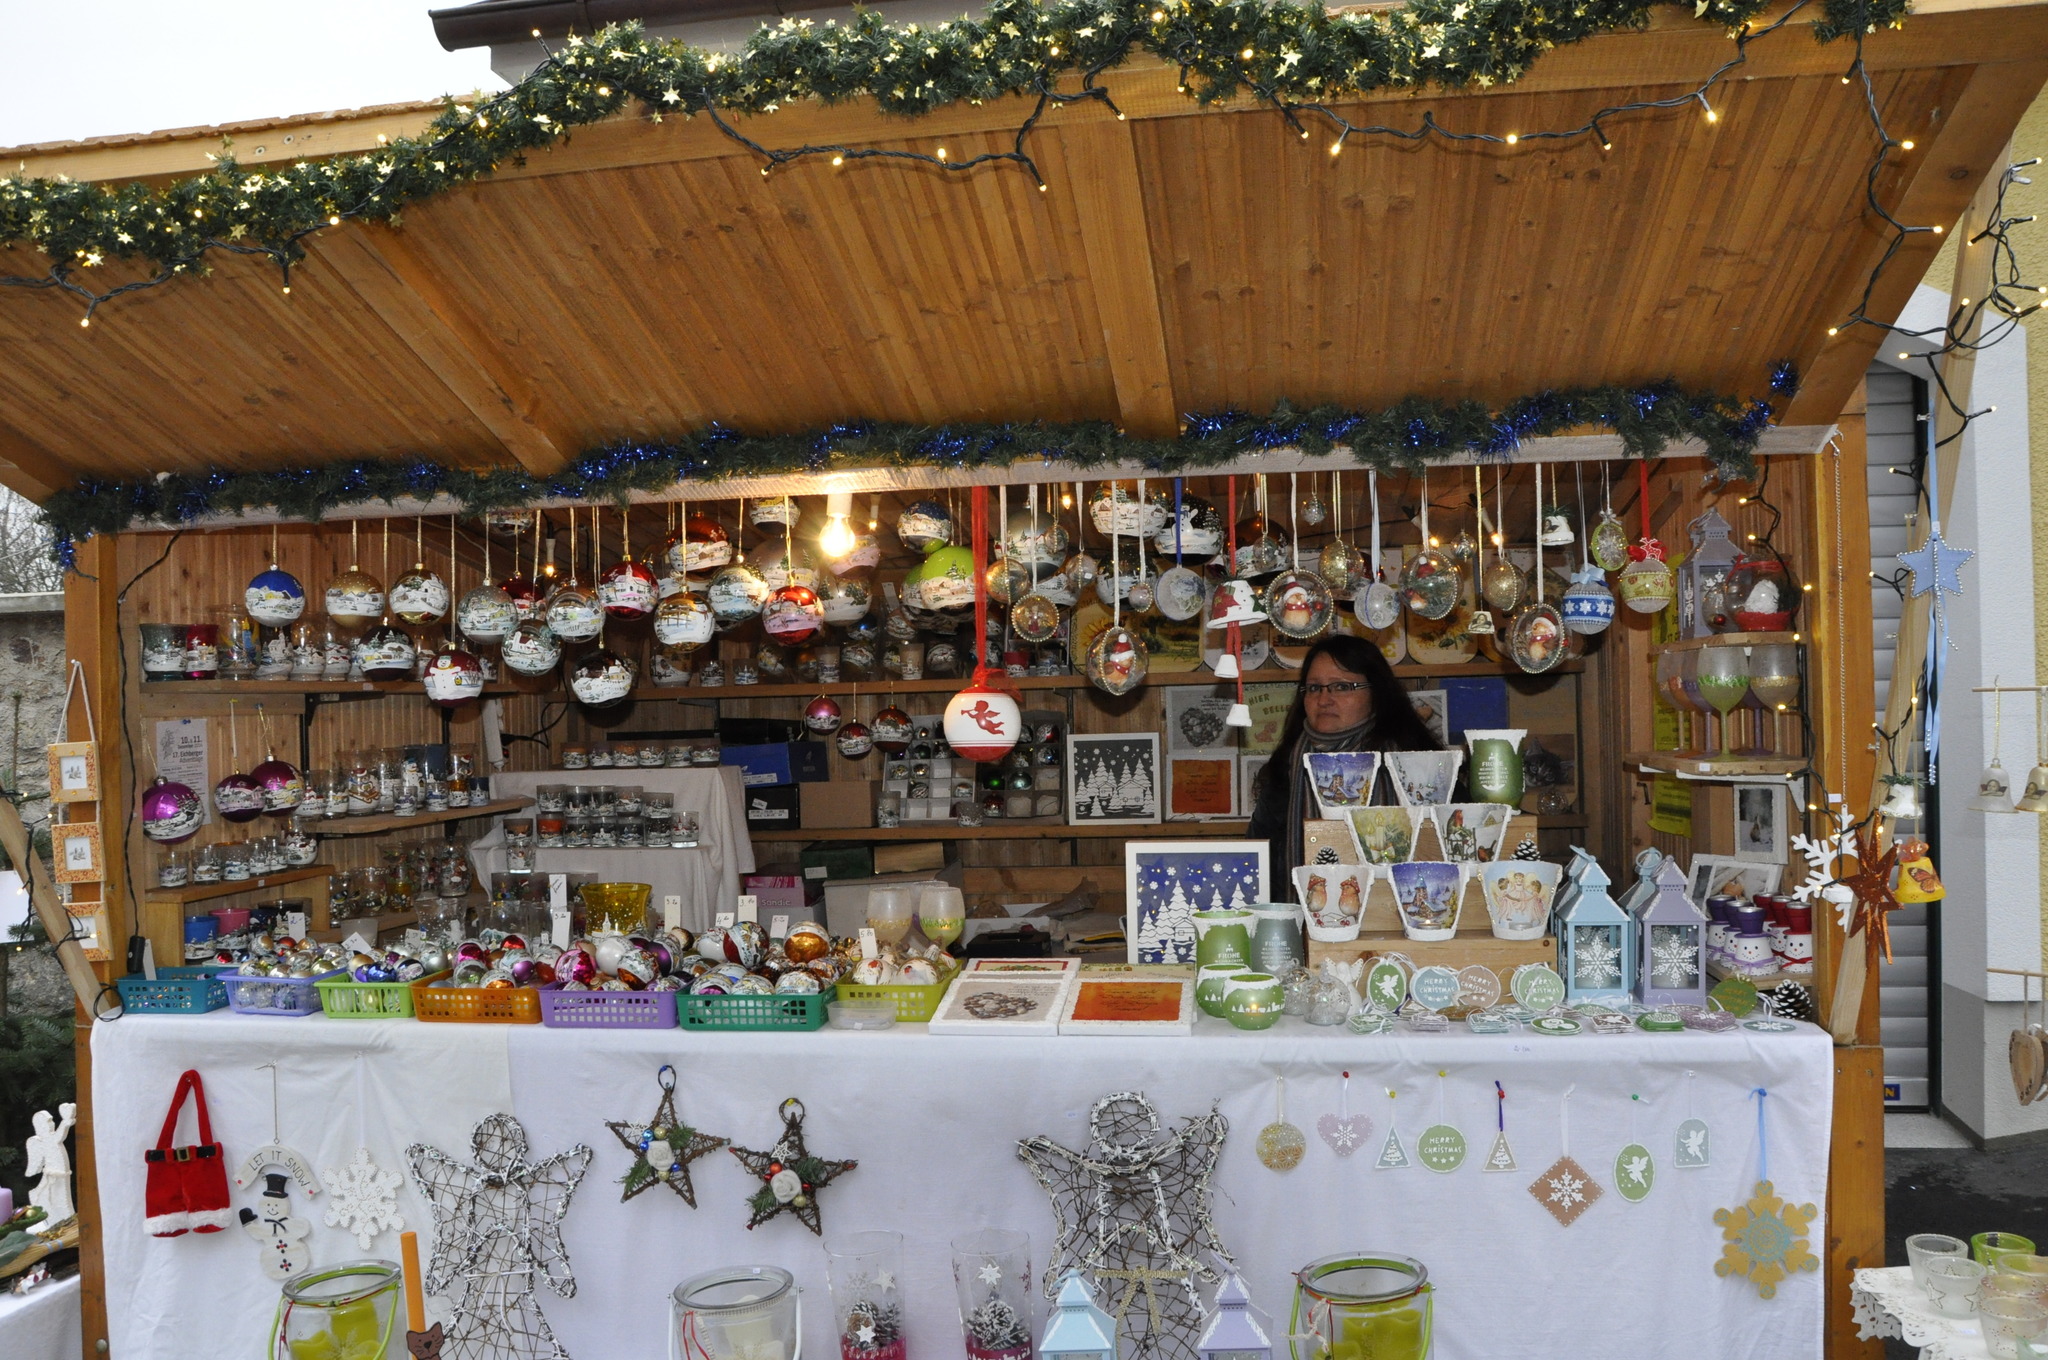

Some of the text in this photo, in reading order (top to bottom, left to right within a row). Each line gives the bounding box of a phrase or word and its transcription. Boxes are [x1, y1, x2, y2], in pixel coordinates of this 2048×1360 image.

[1248, 693, 1270, 706] HIER
[1424, 977, 1448, 985] MERRY
[1468, 974, 1492, 987] MERRY
[1419, 986, 1455, 994] CHRISTMAS
[1429, 1136, 1456, 1144] MERRY
[1423, 1144, 1462, 1154] CHRISTMAS
[248, 1150, 311, 1187] LET IT SNOW
